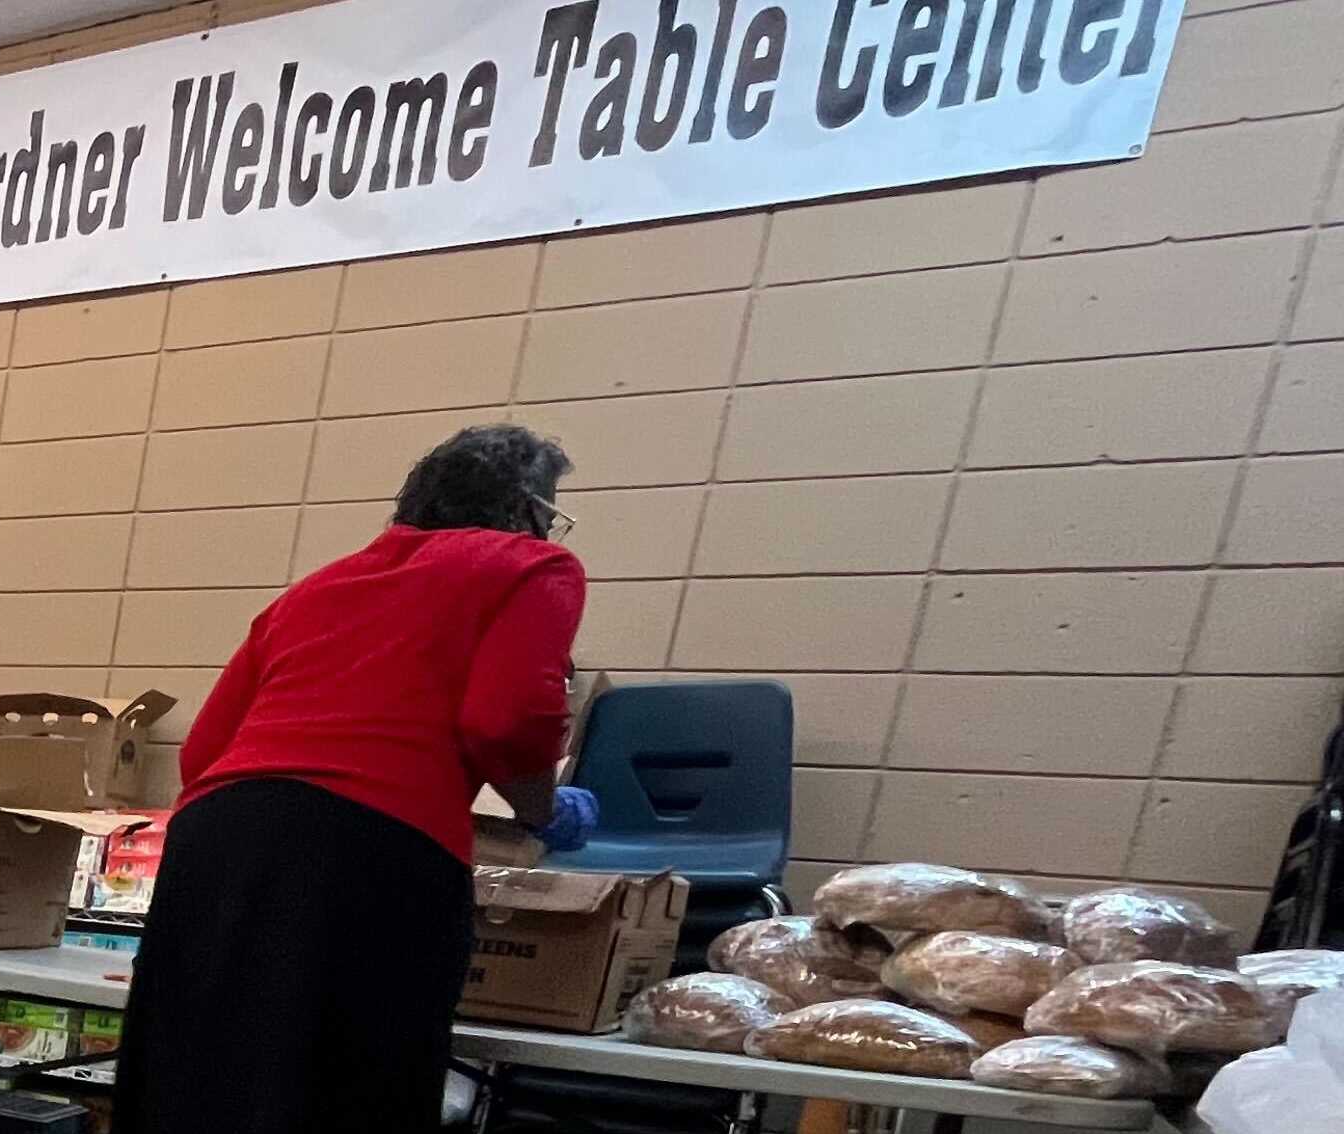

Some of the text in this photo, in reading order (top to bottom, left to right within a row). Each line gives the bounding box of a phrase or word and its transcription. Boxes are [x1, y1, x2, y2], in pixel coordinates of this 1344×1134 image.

[162, 60, 498, 223] Welcome
[529, 0, 790, 168] Table
[815, 0, 1165, 130] Center
